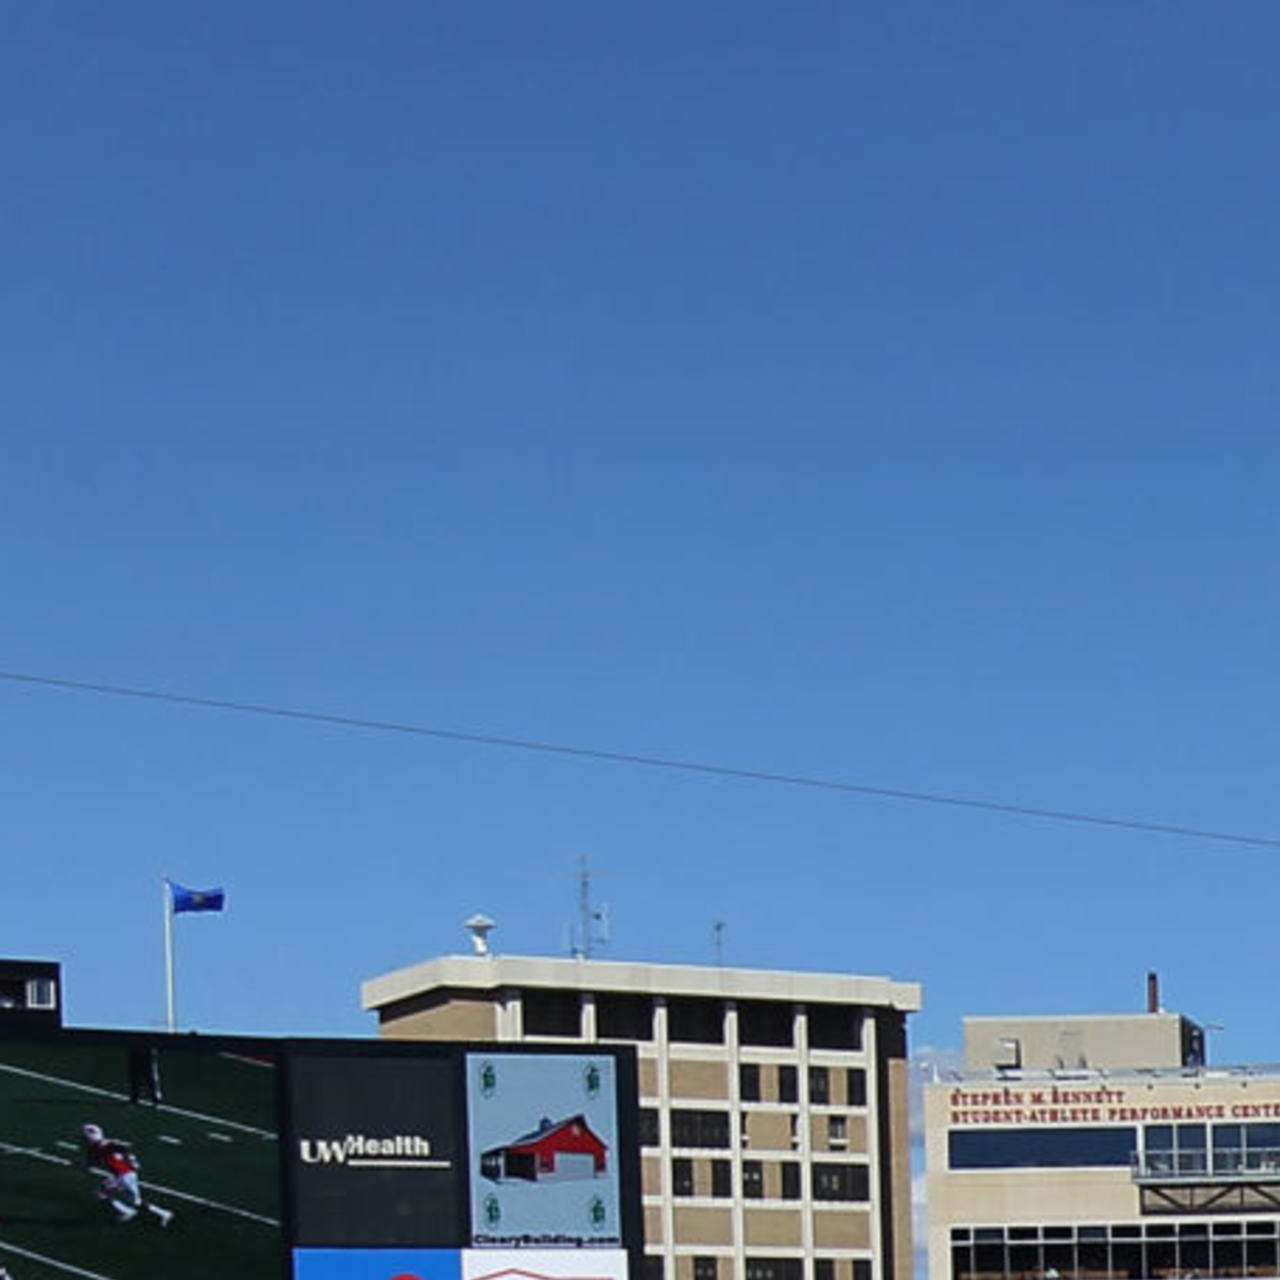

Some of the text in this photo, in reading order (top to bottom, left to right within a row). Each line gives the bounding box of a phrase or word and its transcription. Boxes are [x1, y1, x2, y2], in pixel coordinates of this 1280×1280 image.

[951, 1090, 1023, 1106] STEPHEN
[1051, 1089, 1125, 1104] BENNETT
[951, 1108, 1100, 1123] STUDENT-ATHLETE
[1108, 1105, 1225, 1121] PERFORMANCE
